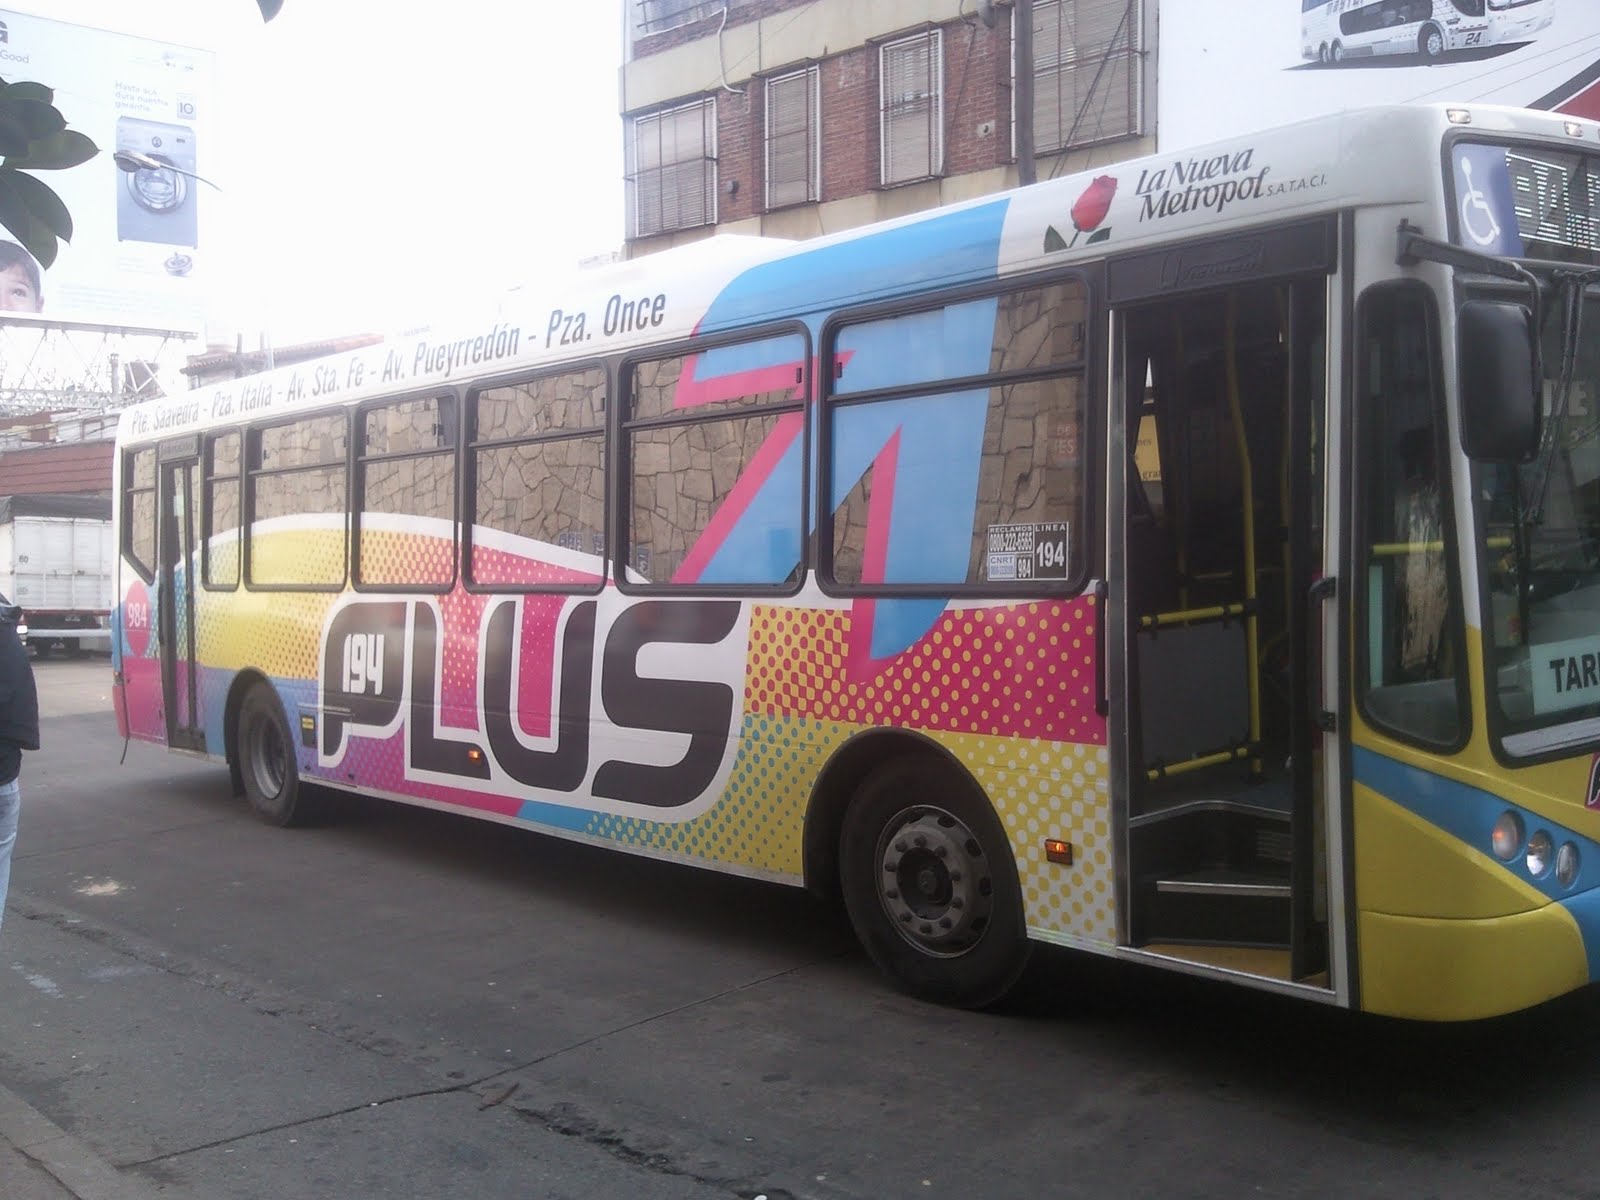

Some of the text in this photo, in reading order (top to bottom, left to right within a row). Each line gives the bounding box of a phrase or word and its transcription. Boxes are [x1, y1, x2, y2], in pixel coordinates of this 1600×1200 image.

[1465, 32, 1482, 45] 24
[0, 49, 30, 64] Good
[1135, 148, 1254, 196] La Nueva
[1138, 166, 1271, 223] Metropol
[212, 392, 235, 418] Pza.
[240, 384, 273, 412] Italia
[287, 379, 306, 402] Av.
[312, 365, 340, 396] Sta.
[346, 357, 363, 389] Fe
[382, 349, 405, 382] Av.
[413, 322, 521, 378] Pueyrredón
[545, 309, 592, 349] Pza.
[603, 293, 667, 337] Once
[989, 525, 1033, 534] RECLAMOS
[990, 556, 1014, 565] CNRT
[1036, 541, 1065, 568] 194
[128, 602, 147, 628] 984
[342, 633, 384, 695] 194
[321, 599, 743, 808] PLUS
